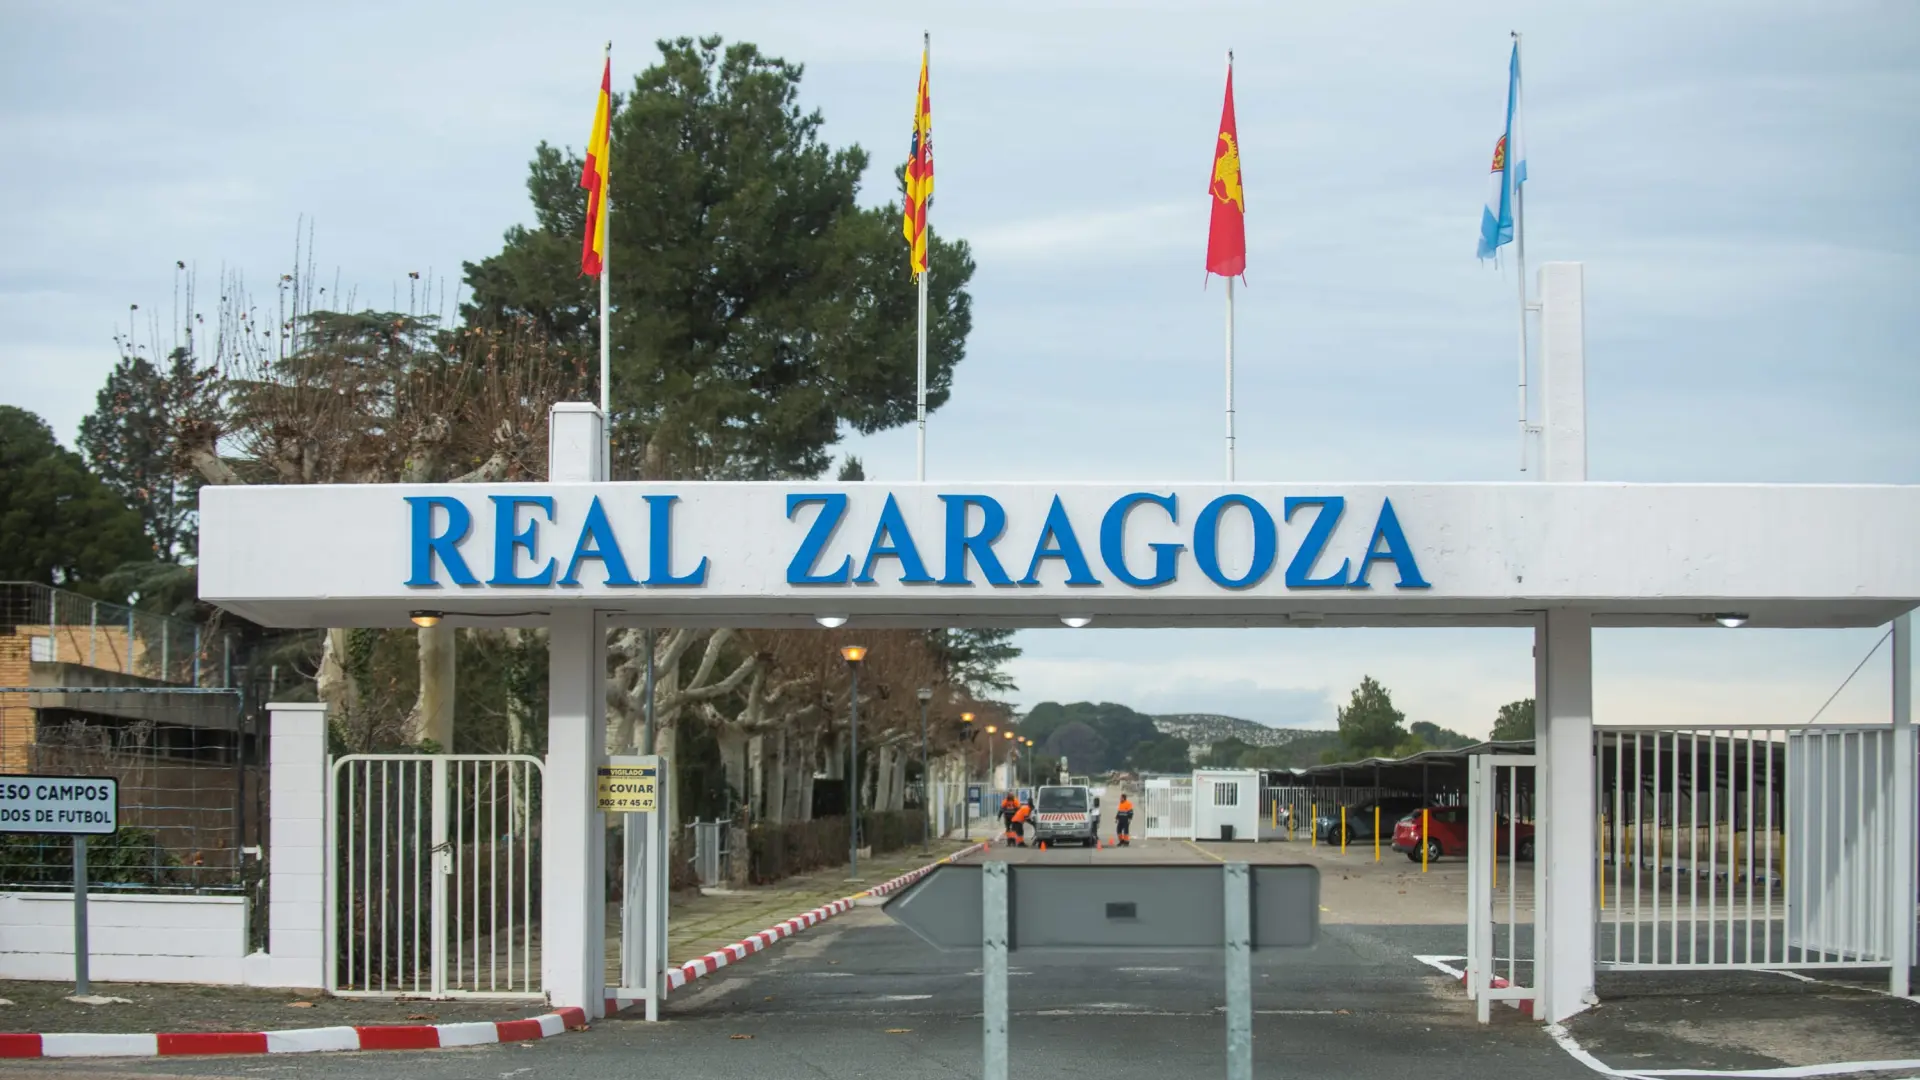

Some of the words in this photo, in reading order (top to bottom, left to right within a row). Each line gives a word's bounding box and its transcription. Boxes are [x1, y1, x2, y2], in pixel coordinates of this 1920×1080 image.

[403, 494, 708, 587] REAL
[786, 491, 1432, 589] ZARAGOZA
[36, 785, 109, 801] CAMPOS
[609, 783, 654, 793] COVIAR
[630, 799, 641, 807] 45
[643, 799, 653, 807] 47
[1, 808, 31, 822] DOS
[35, 809, 54, 823] DE
[58, 810, 112, 824] FUTBOL
